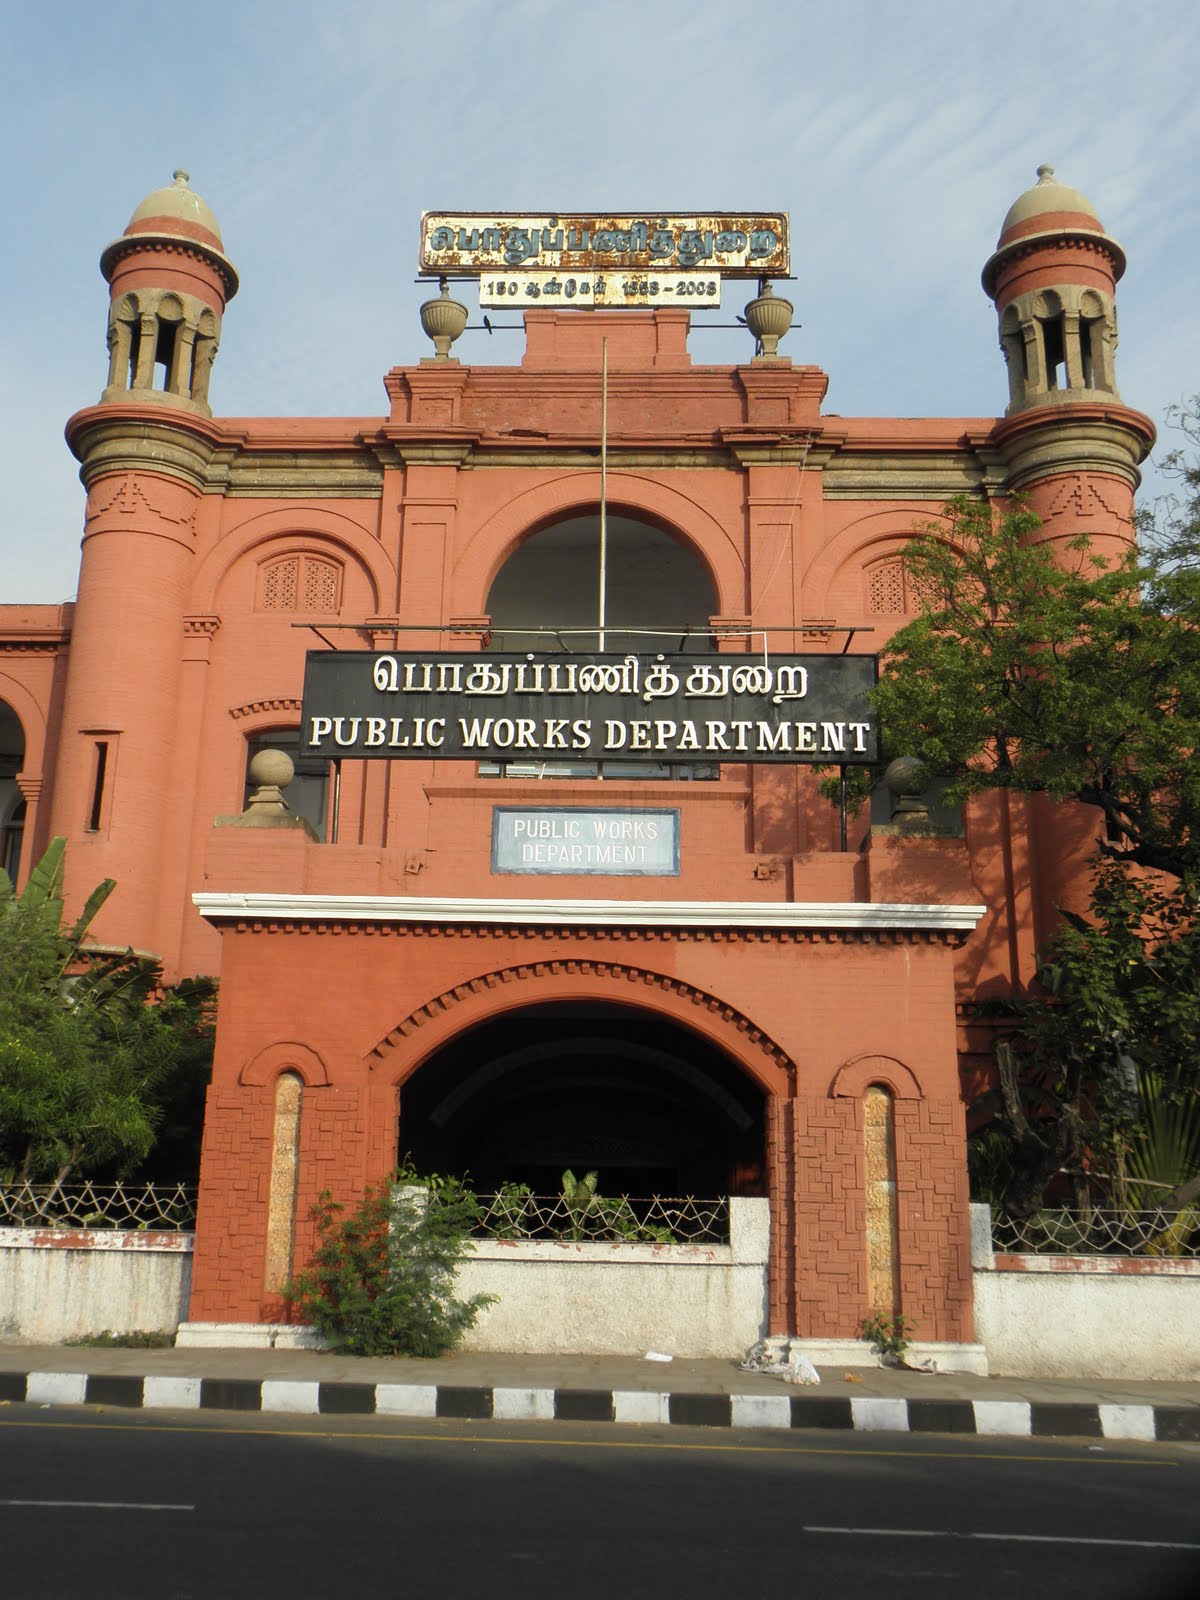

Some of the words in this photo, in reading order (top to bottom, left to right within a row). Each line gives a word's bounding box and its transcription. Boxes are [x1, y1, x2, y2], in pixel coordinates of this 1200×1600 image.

[430, 218, 777, 265] பொதுப்பணித்துறை
[487, 281, 518, 296] 150
[373, 653, 808, 704] பொதுப்பணித்துறை
[309, 717, 446, 747] PUBLIC
[459, 718, 592, 749] WORKS
[604, 720, 870, 752] DEPARTMENT
[514, 820, 580, 838] PUBLIC
[594, 821, 658, 839] WORKS
[522, 844, 648, 863] DEPARTMENT
